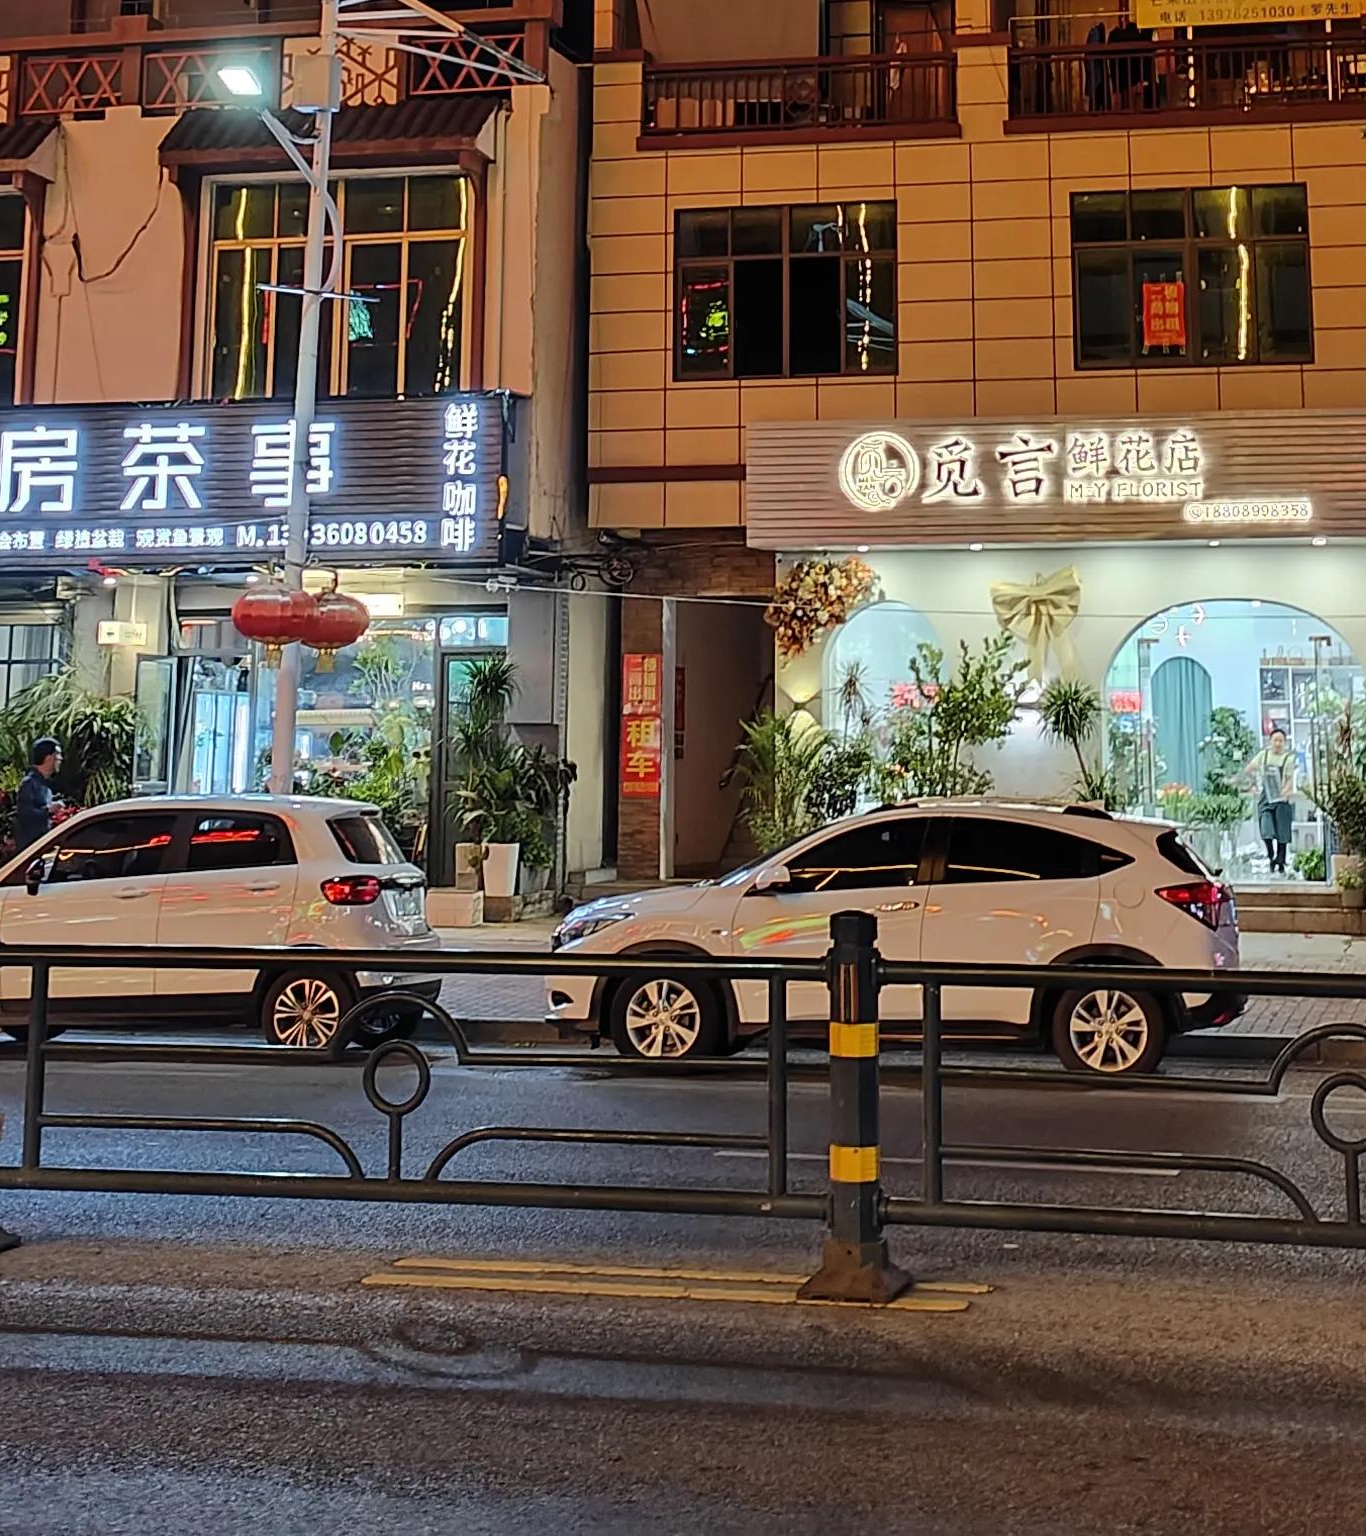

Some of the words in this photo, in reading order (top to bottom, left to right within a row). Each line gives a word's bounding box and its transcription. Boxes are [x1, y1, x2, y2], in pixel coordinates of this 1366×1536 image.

[1160, 10, 1187, 23] 电话
[440, 402, 479, 553] 鲜花咖啡
[923, 434, 1055, 499] 觅言
[1068, 432, 1202, 475] 鲜花店
[1116, 481, 1202, 498] FLORIST
[626, 720, 657, 778] 租车
